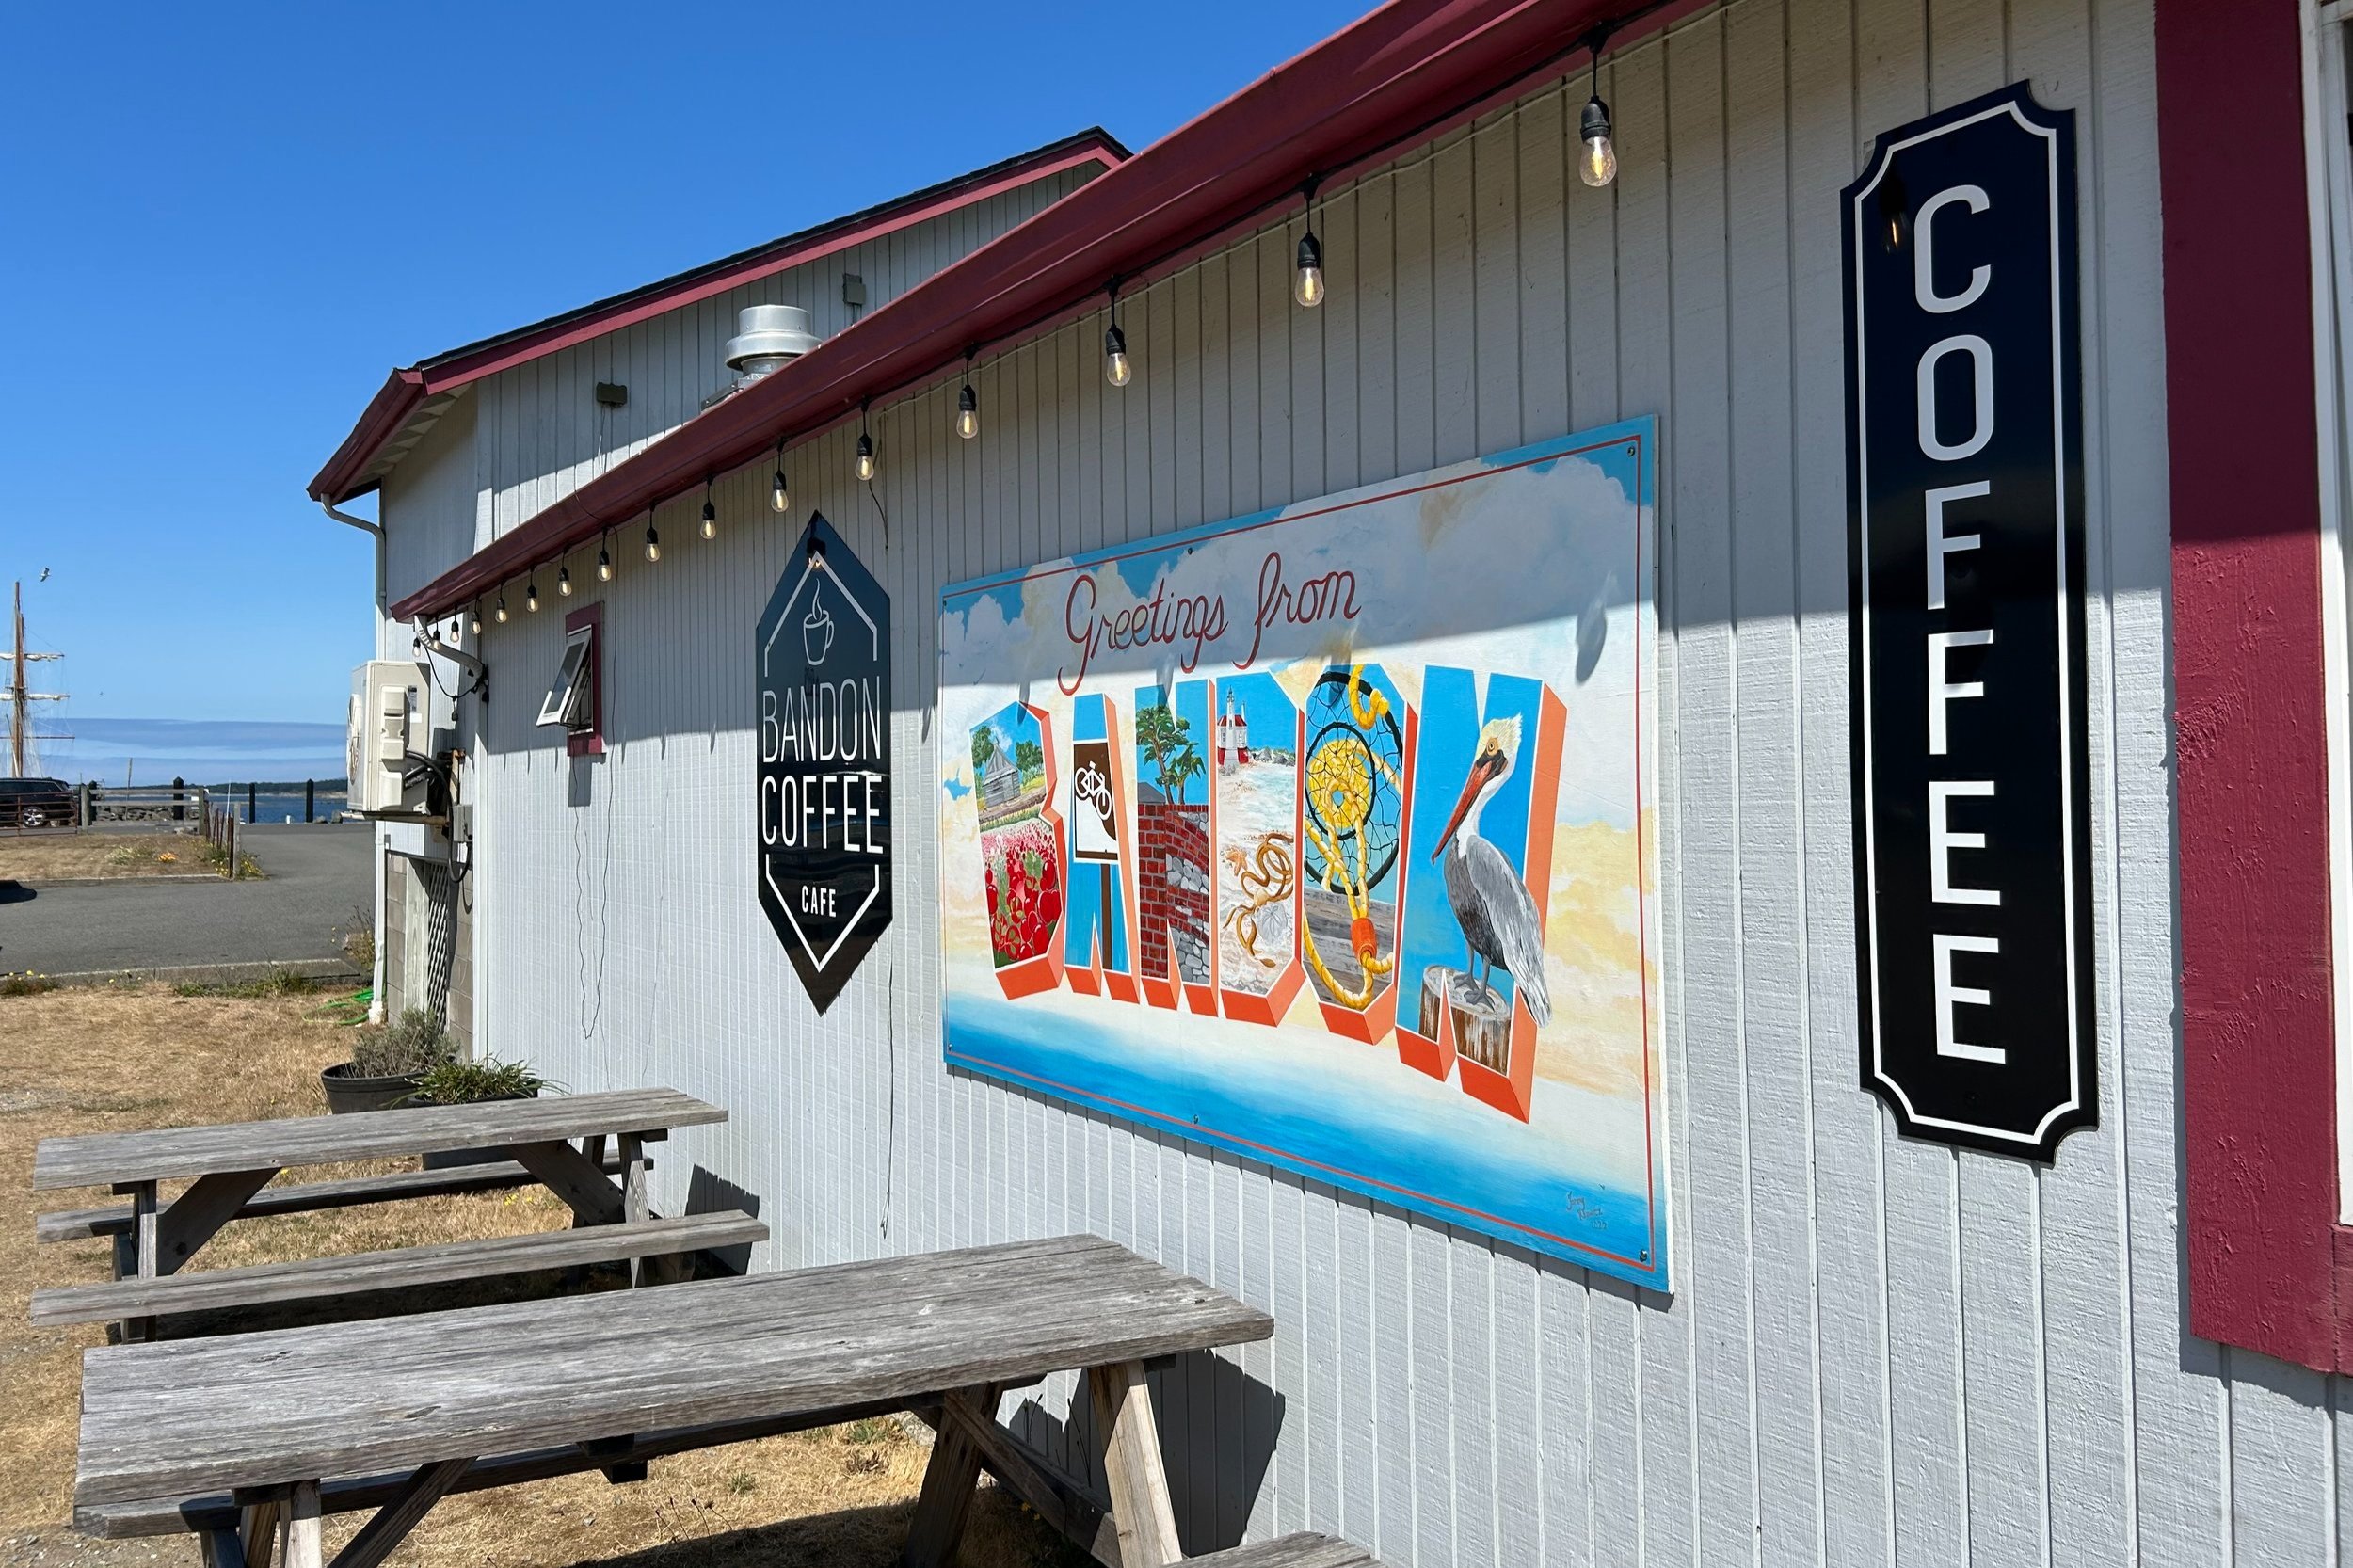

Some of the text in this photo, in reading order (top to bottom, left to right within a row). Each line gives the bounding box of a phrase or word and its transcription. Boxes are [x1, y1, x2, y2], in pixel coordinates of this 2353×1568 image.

[1057, 552, 1362, 696] Greetings from
[1913, 183, 2007, 1064] COFFEE
[762, 676, 881, 763] BANDON
[761, 775, 884, 855] COFFEE
[801, 885, 837, 919] CAFE
[969, 663, 1566, 1124] BANDON
